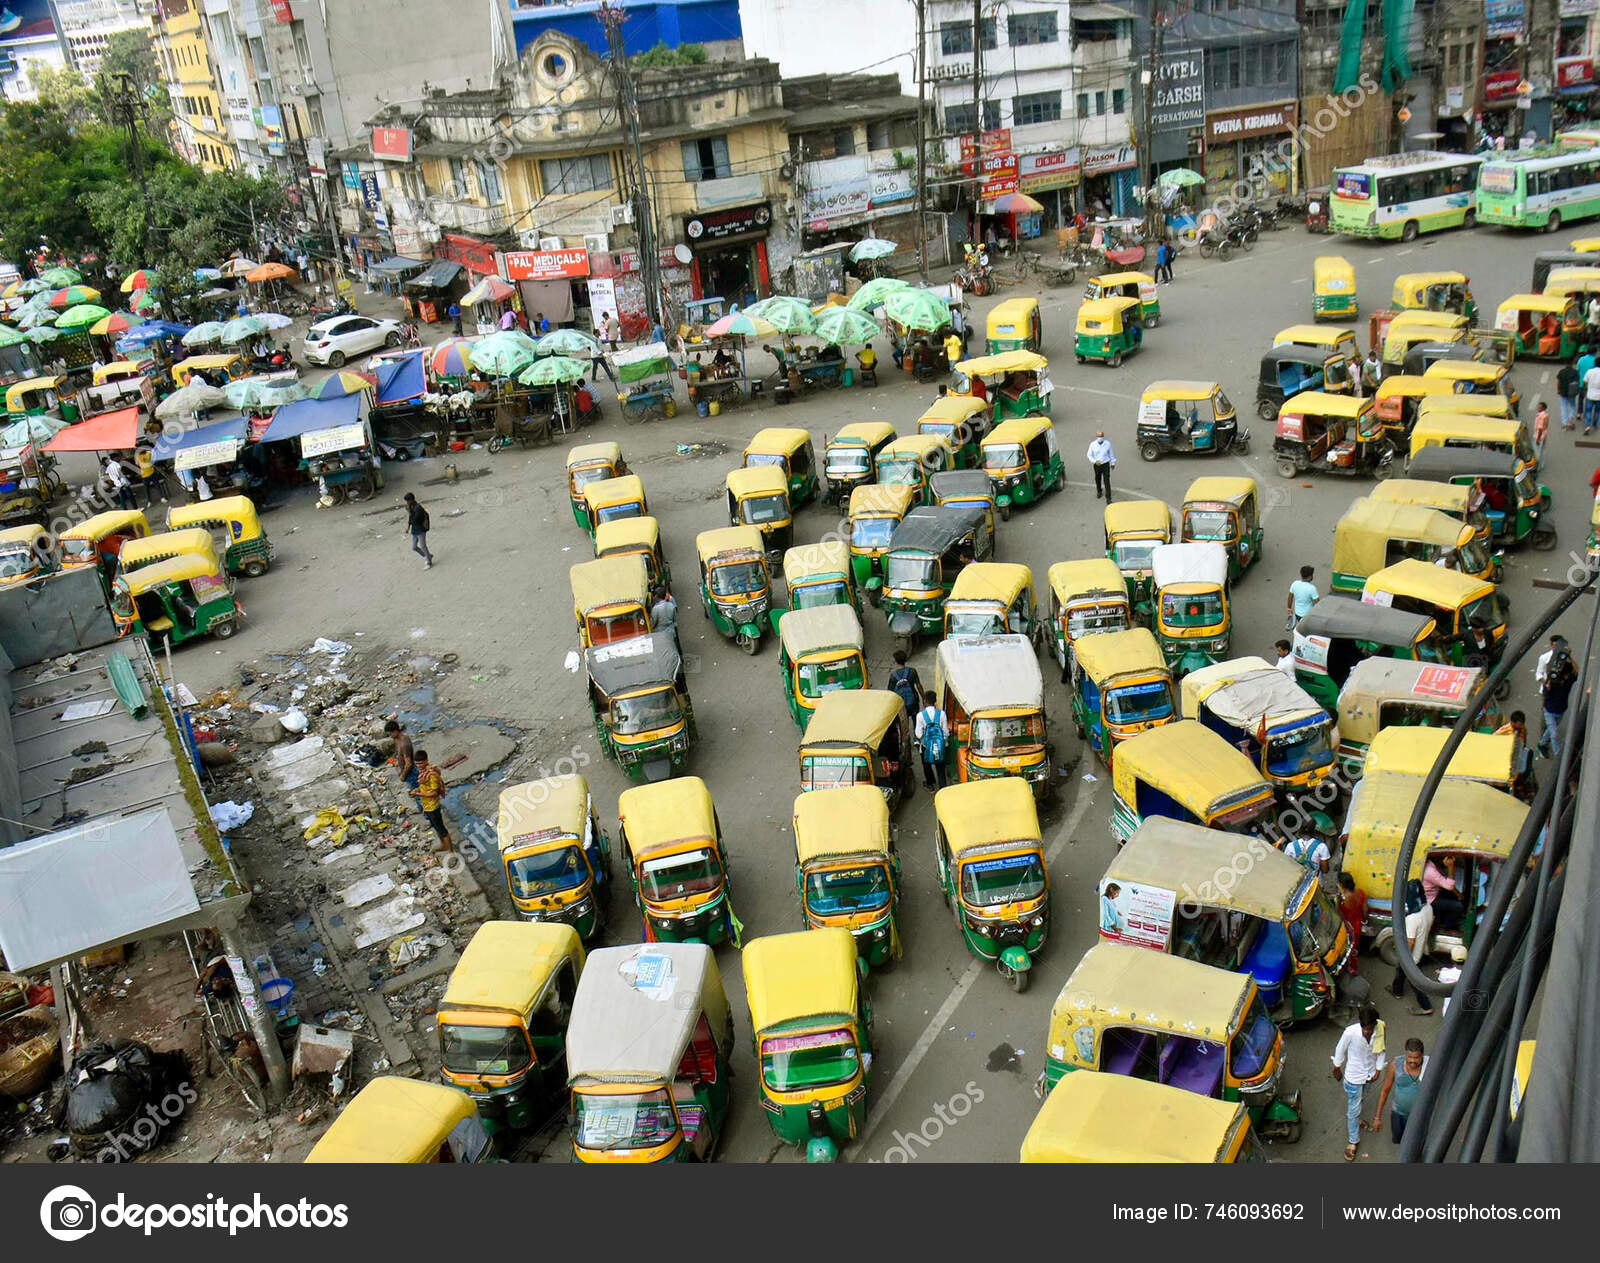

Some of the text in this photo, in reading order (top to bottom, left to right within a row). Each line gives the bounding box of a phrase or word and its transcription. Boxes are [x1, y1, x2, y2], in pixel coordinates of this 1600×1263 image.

[1153, 61, 1198, 81] OTEL
[1152, 85, 1202, 107] DARSH
[1213, 118, 1242, 135] PATNA
[1085, 153, 1115, 164] RALSON
[513, 256, 531, 268] PAL
[534, 252, 581, 267] MEDICALS
[989, 894, 1008, 904] Uber
